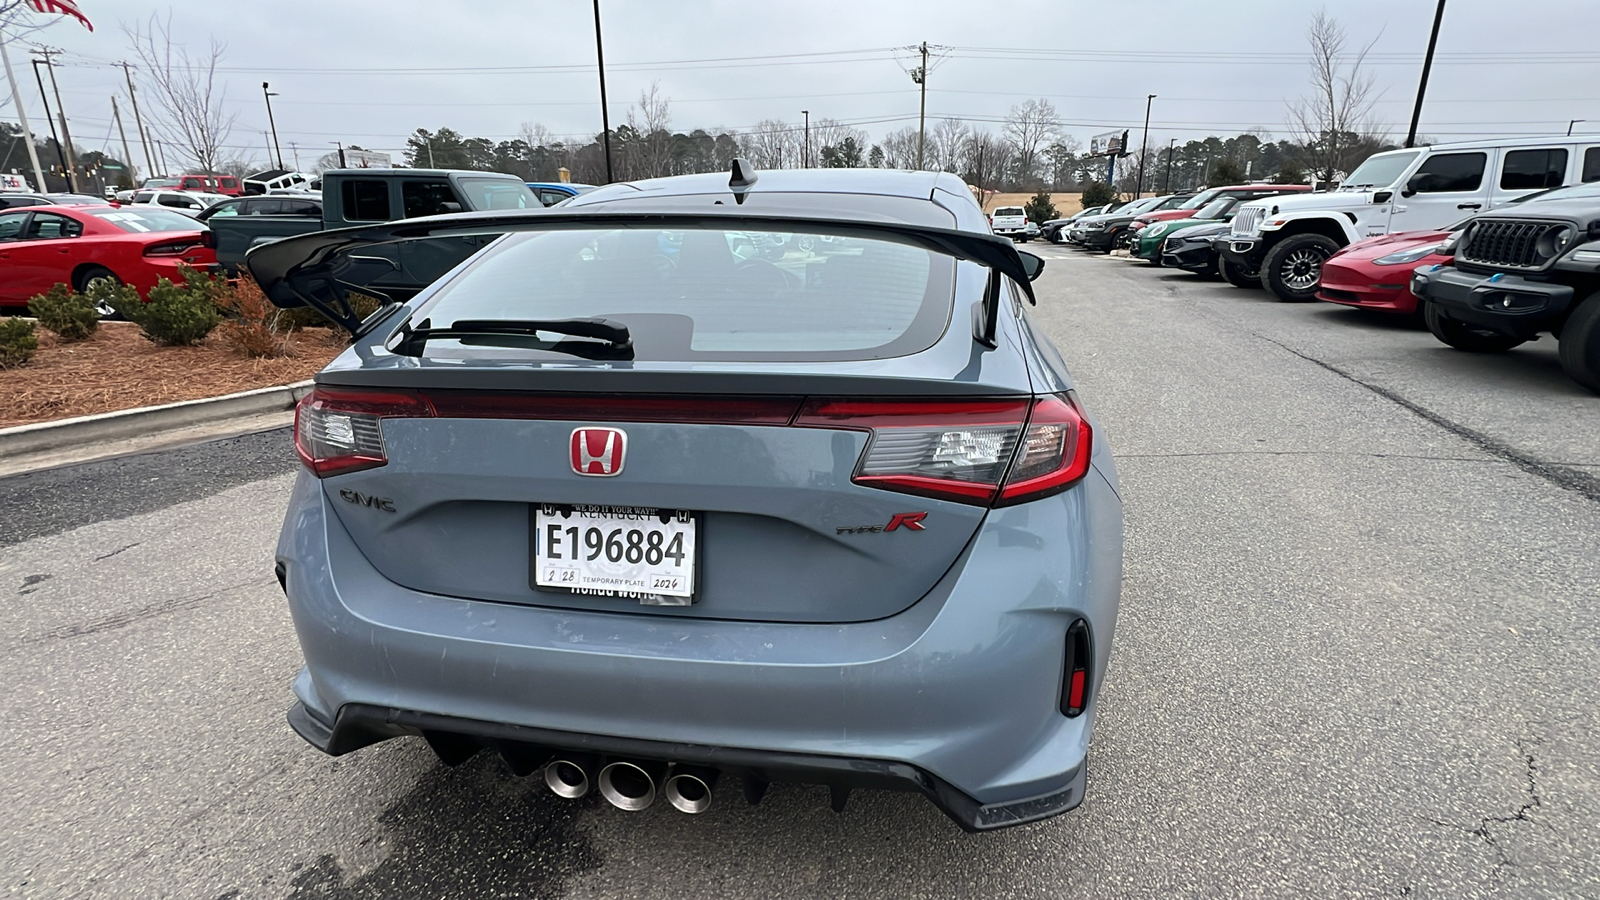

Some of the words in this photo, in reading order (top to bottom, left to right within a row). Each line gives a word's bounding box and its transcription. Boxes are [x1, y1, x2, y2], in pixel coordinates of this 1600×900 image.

[339, 487, 397, 513] CIVIC
[588, 505, 600, 513] DO
[601, 505, 611, 513] IT
[611, 506, 633, 514] YOUR
[835, 525, 883, 535] TYPE
[883, 510, 929, 532] R
[547, 524, 686, 568] E196884
[548, 570, 556, 582] 2
[562, 570, 576, 582] 28
[582, 576, 624, 585] TEMPORARY
[624, 579, 646, 587] PLATE
